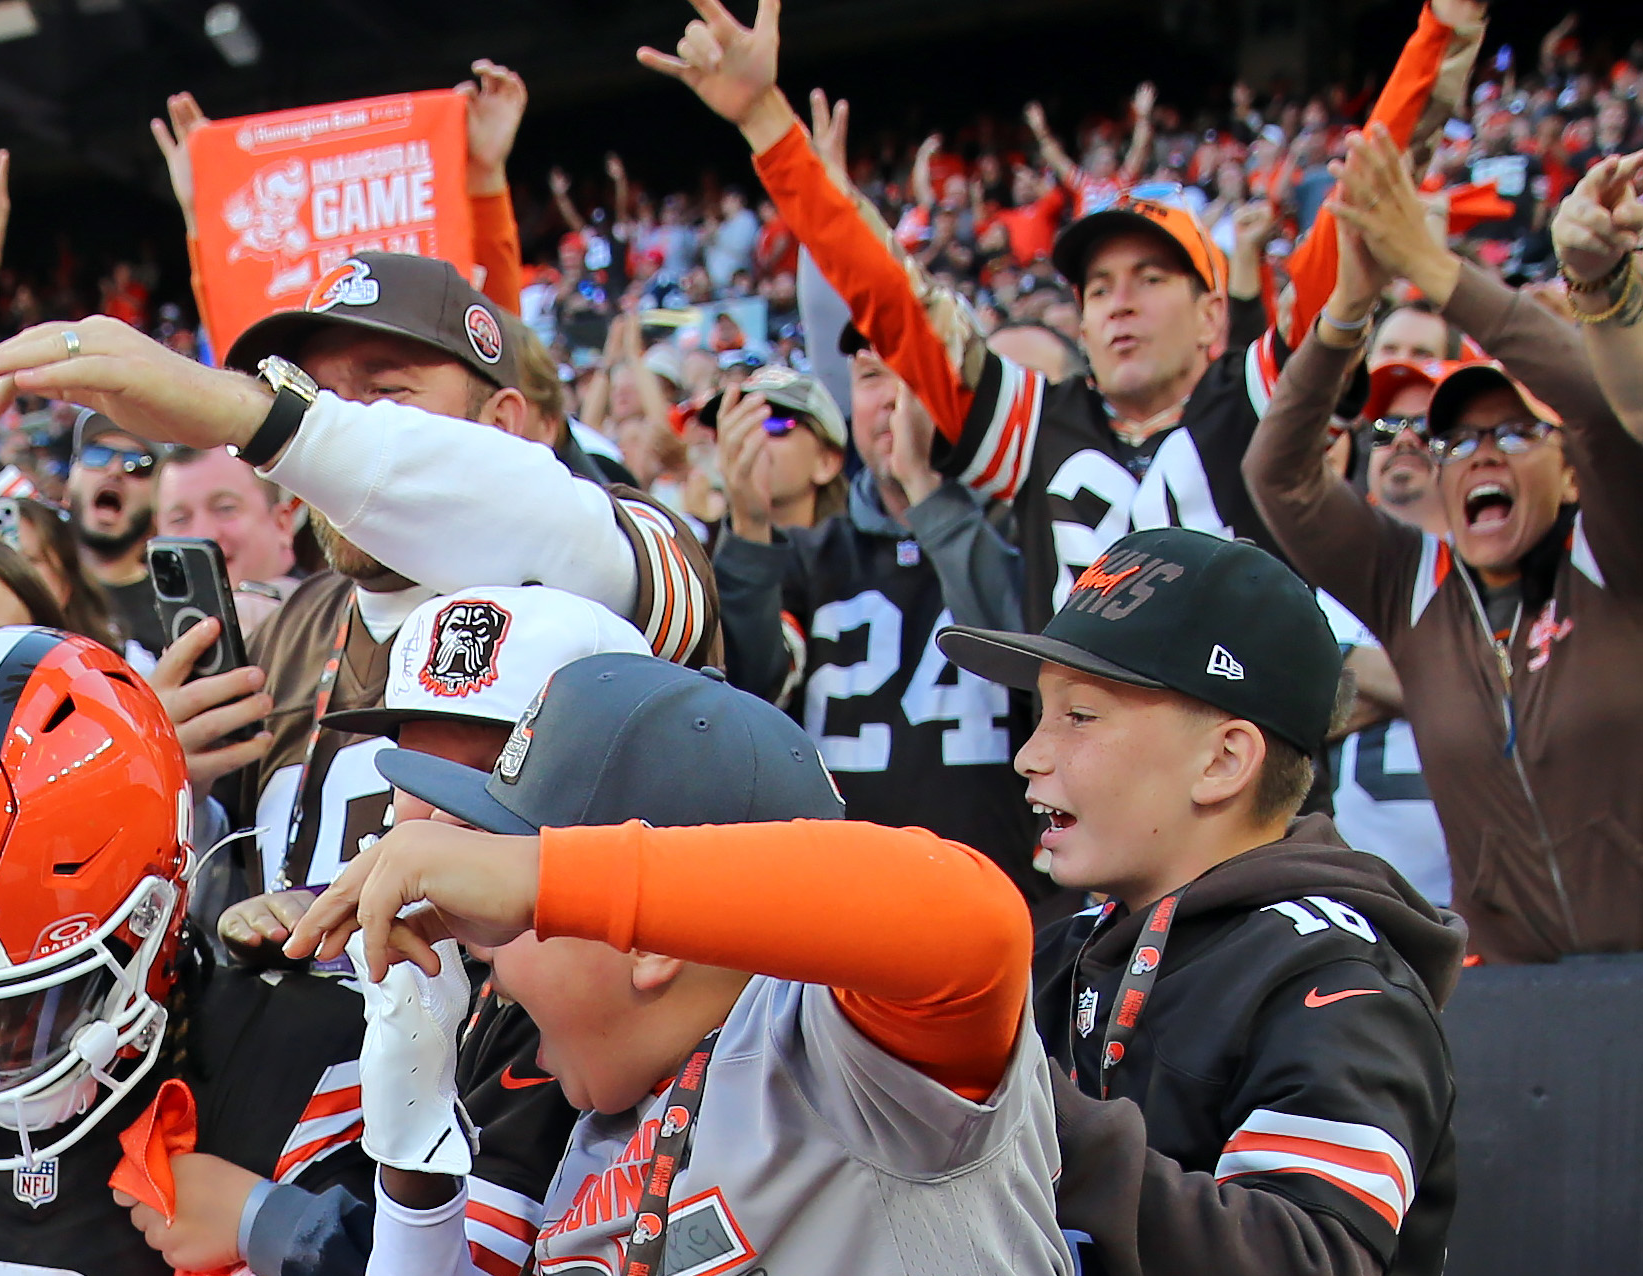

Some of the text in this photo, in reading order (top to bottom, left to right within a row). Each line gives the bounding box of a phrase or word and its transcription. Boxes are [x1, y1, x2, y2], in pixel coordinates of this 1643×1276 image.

[312, 170, 435, 240] GAME
[803, 590, 1010, 772] 24
[22, 1176, 50, 1196] NFL
